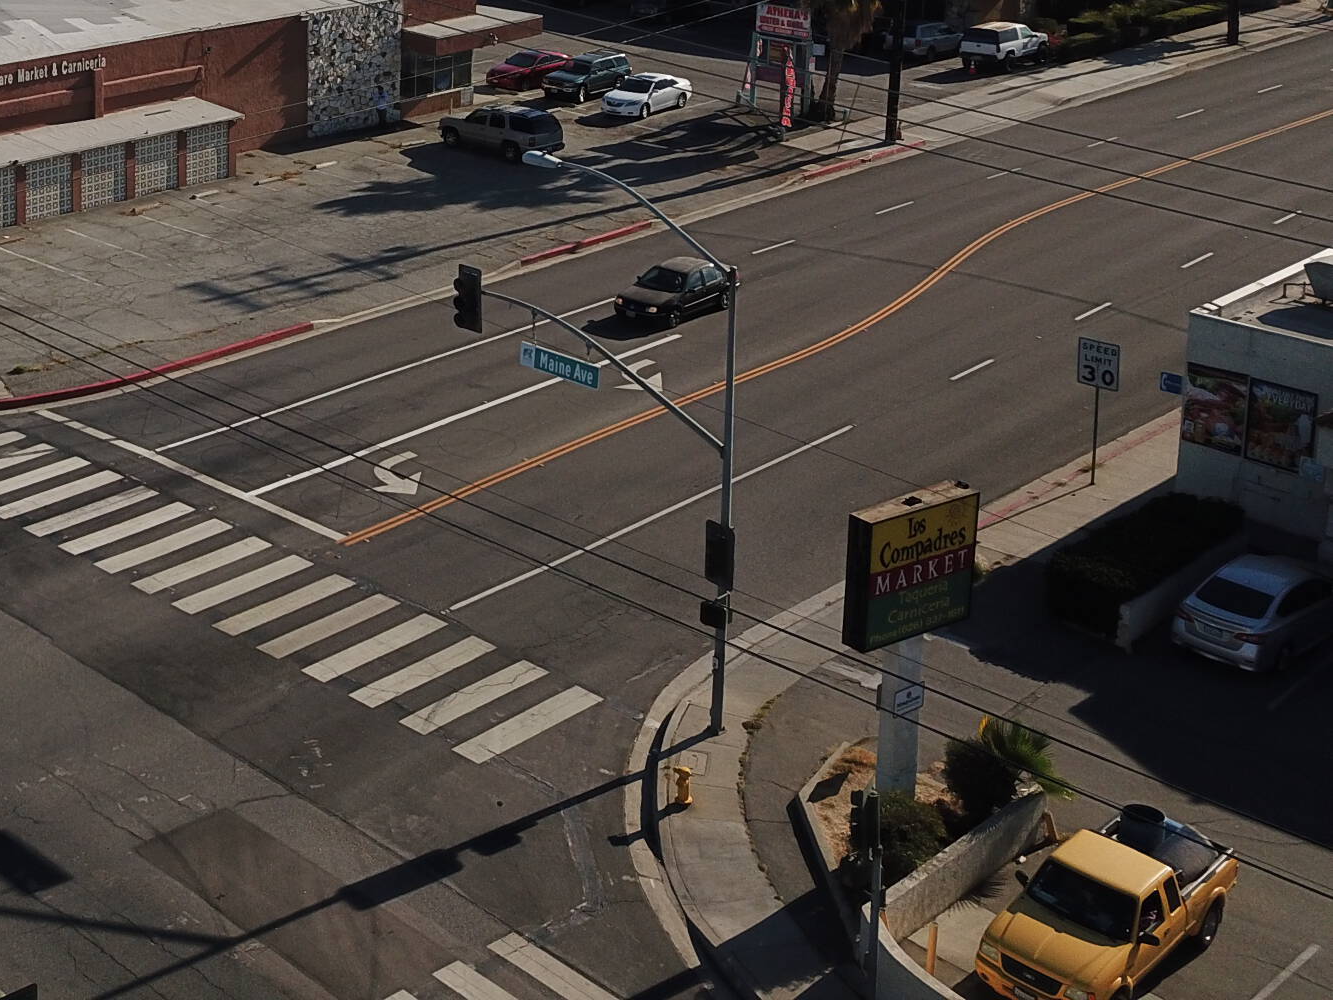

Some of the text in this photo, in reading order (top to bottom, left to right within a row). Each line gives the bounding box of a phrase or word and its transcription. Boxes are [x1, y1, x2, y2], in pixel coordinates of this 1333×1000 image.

[17, 65, 49, 83] Market
[52, 62, 58, 77] &
[61, 53, 107, 76] Carniceria
[1082, 342, 1117, 357] SPEED
[1084, 353, 1113, 367] LIMIT
[539, 351, 594, 385] Maine Ave
[1081, 364, 1115, 386] 30
[908, 517, 926, 539] Los
[880, 526, 967, 569] Compadres
[874, 549, 969, 596] MARKET
[888, 595, 951, 625] Carniceria
